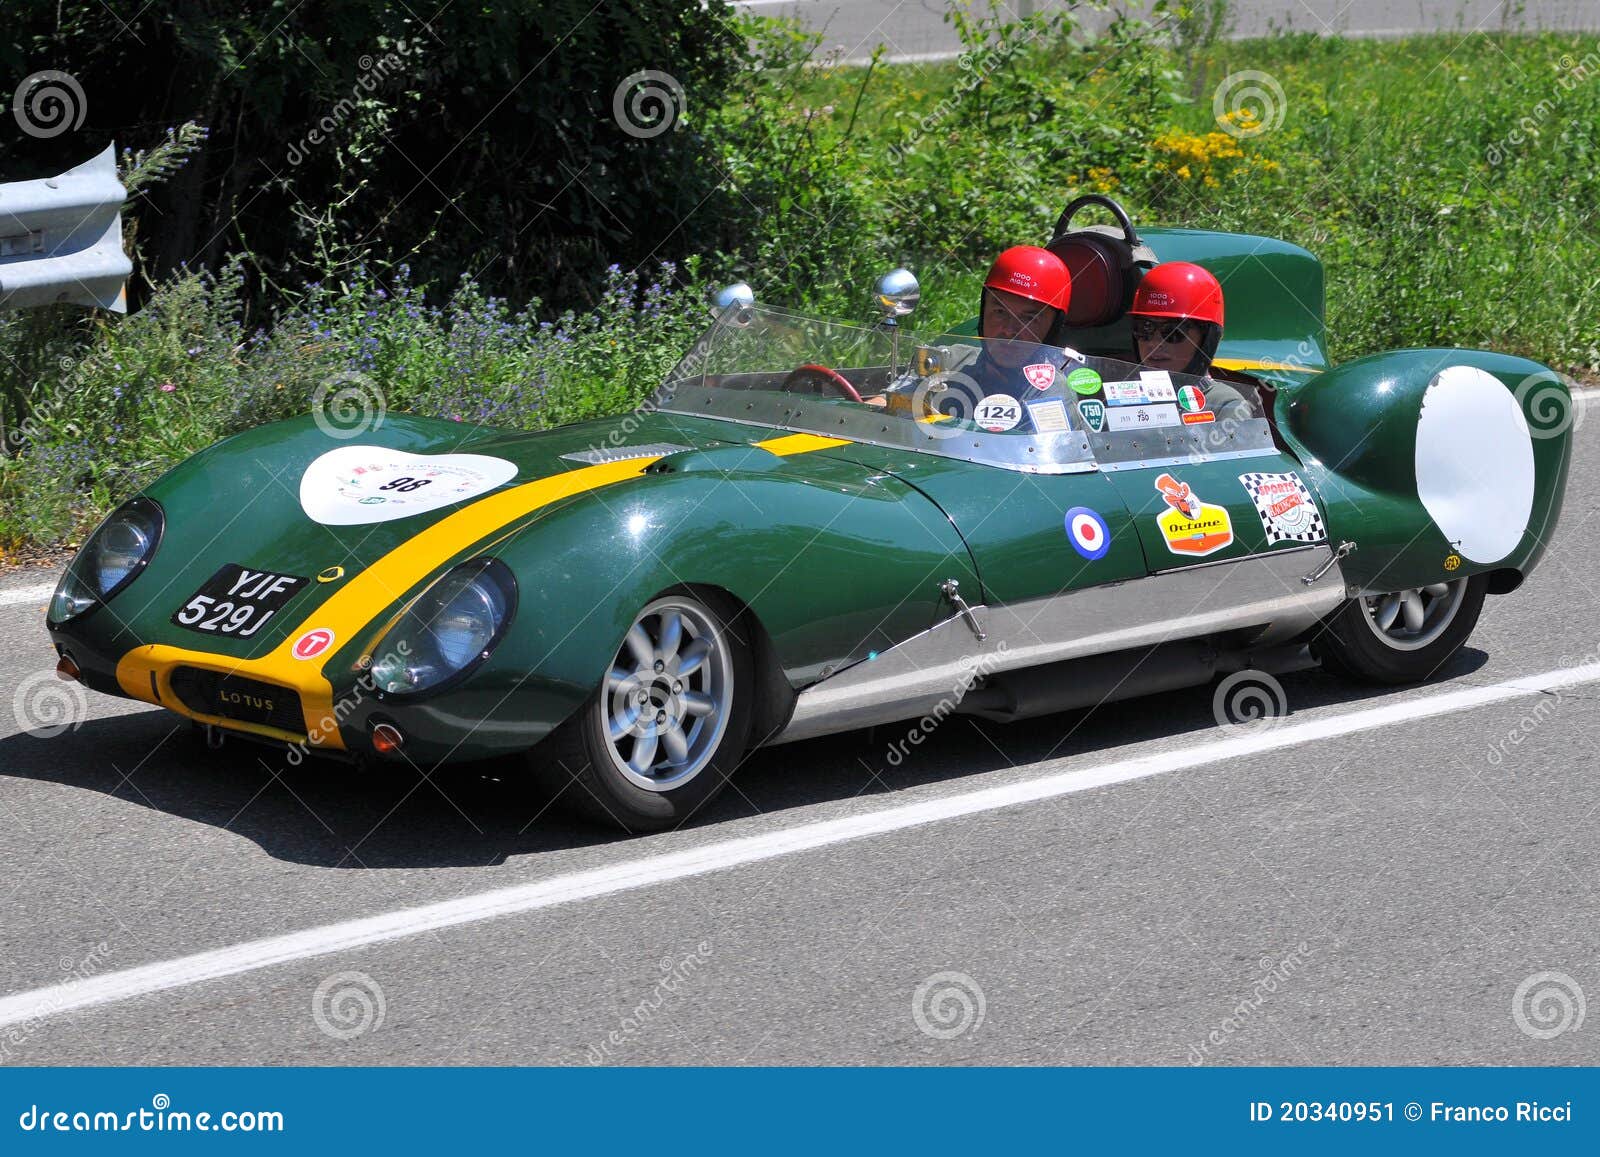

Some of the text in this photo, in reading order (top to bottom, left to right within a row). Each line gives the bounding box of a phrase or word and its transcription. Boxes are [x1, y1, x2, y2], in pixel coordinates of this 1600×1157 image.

[1013, 272, 1031, 281] 1000
[980, 406, 1016, 419] 124
[1082, 404, 1101, 417] 750
[379, 477, 432, 492] 98
[1259, 482, 1295, 496] SPORTS
[1169, 519, 1223, 533] Octane
[227, 570, 297, 600] YJF
[178, 595, 275, 636] 529J
[303, 635, 326, 654] T
[220, 690, 274, 711] LOTUS
